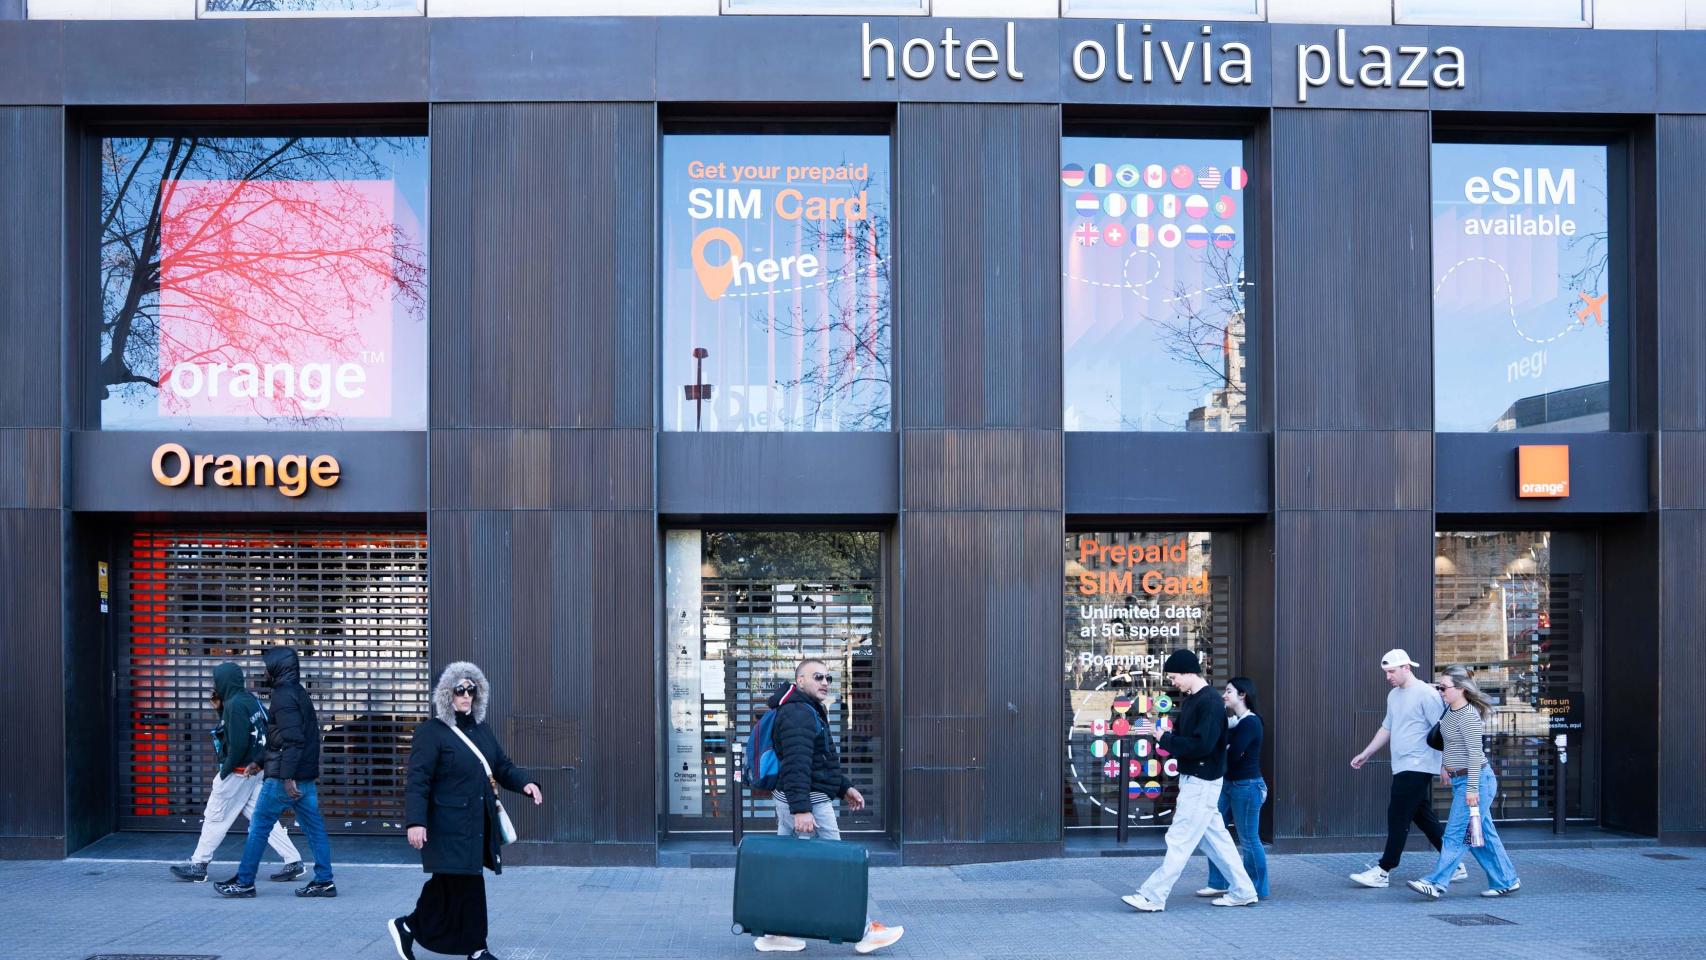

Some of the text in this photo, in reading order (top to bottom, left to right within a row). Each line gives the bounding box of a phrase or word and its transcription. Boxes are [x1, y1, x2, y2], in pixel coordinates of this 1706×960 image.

[861, 22, 1467, 102] hotel olivia plaza
[687, 161, 869, 184] Get your prepaid
[1464, 166, 1576, 205] eSIM
[688, 188, 867, 221] SIM Card
[1464, 214, 1577, 236] available
[731, 253, 819, 287] here
[171, 361, 367, 411] orange
[151, 443, 341, 498] Orange
[1522, 482, 1564, 495] orange
[1079, 538, 1187, 568] Prepaid
[1079, 569, 1209, 595] SIM Card
[1080, 604, 1201, 619] Unlimited data
[1080, 622, 1180, 639] at 5G speed
[1080, 651, 1155, 668] Roaming
